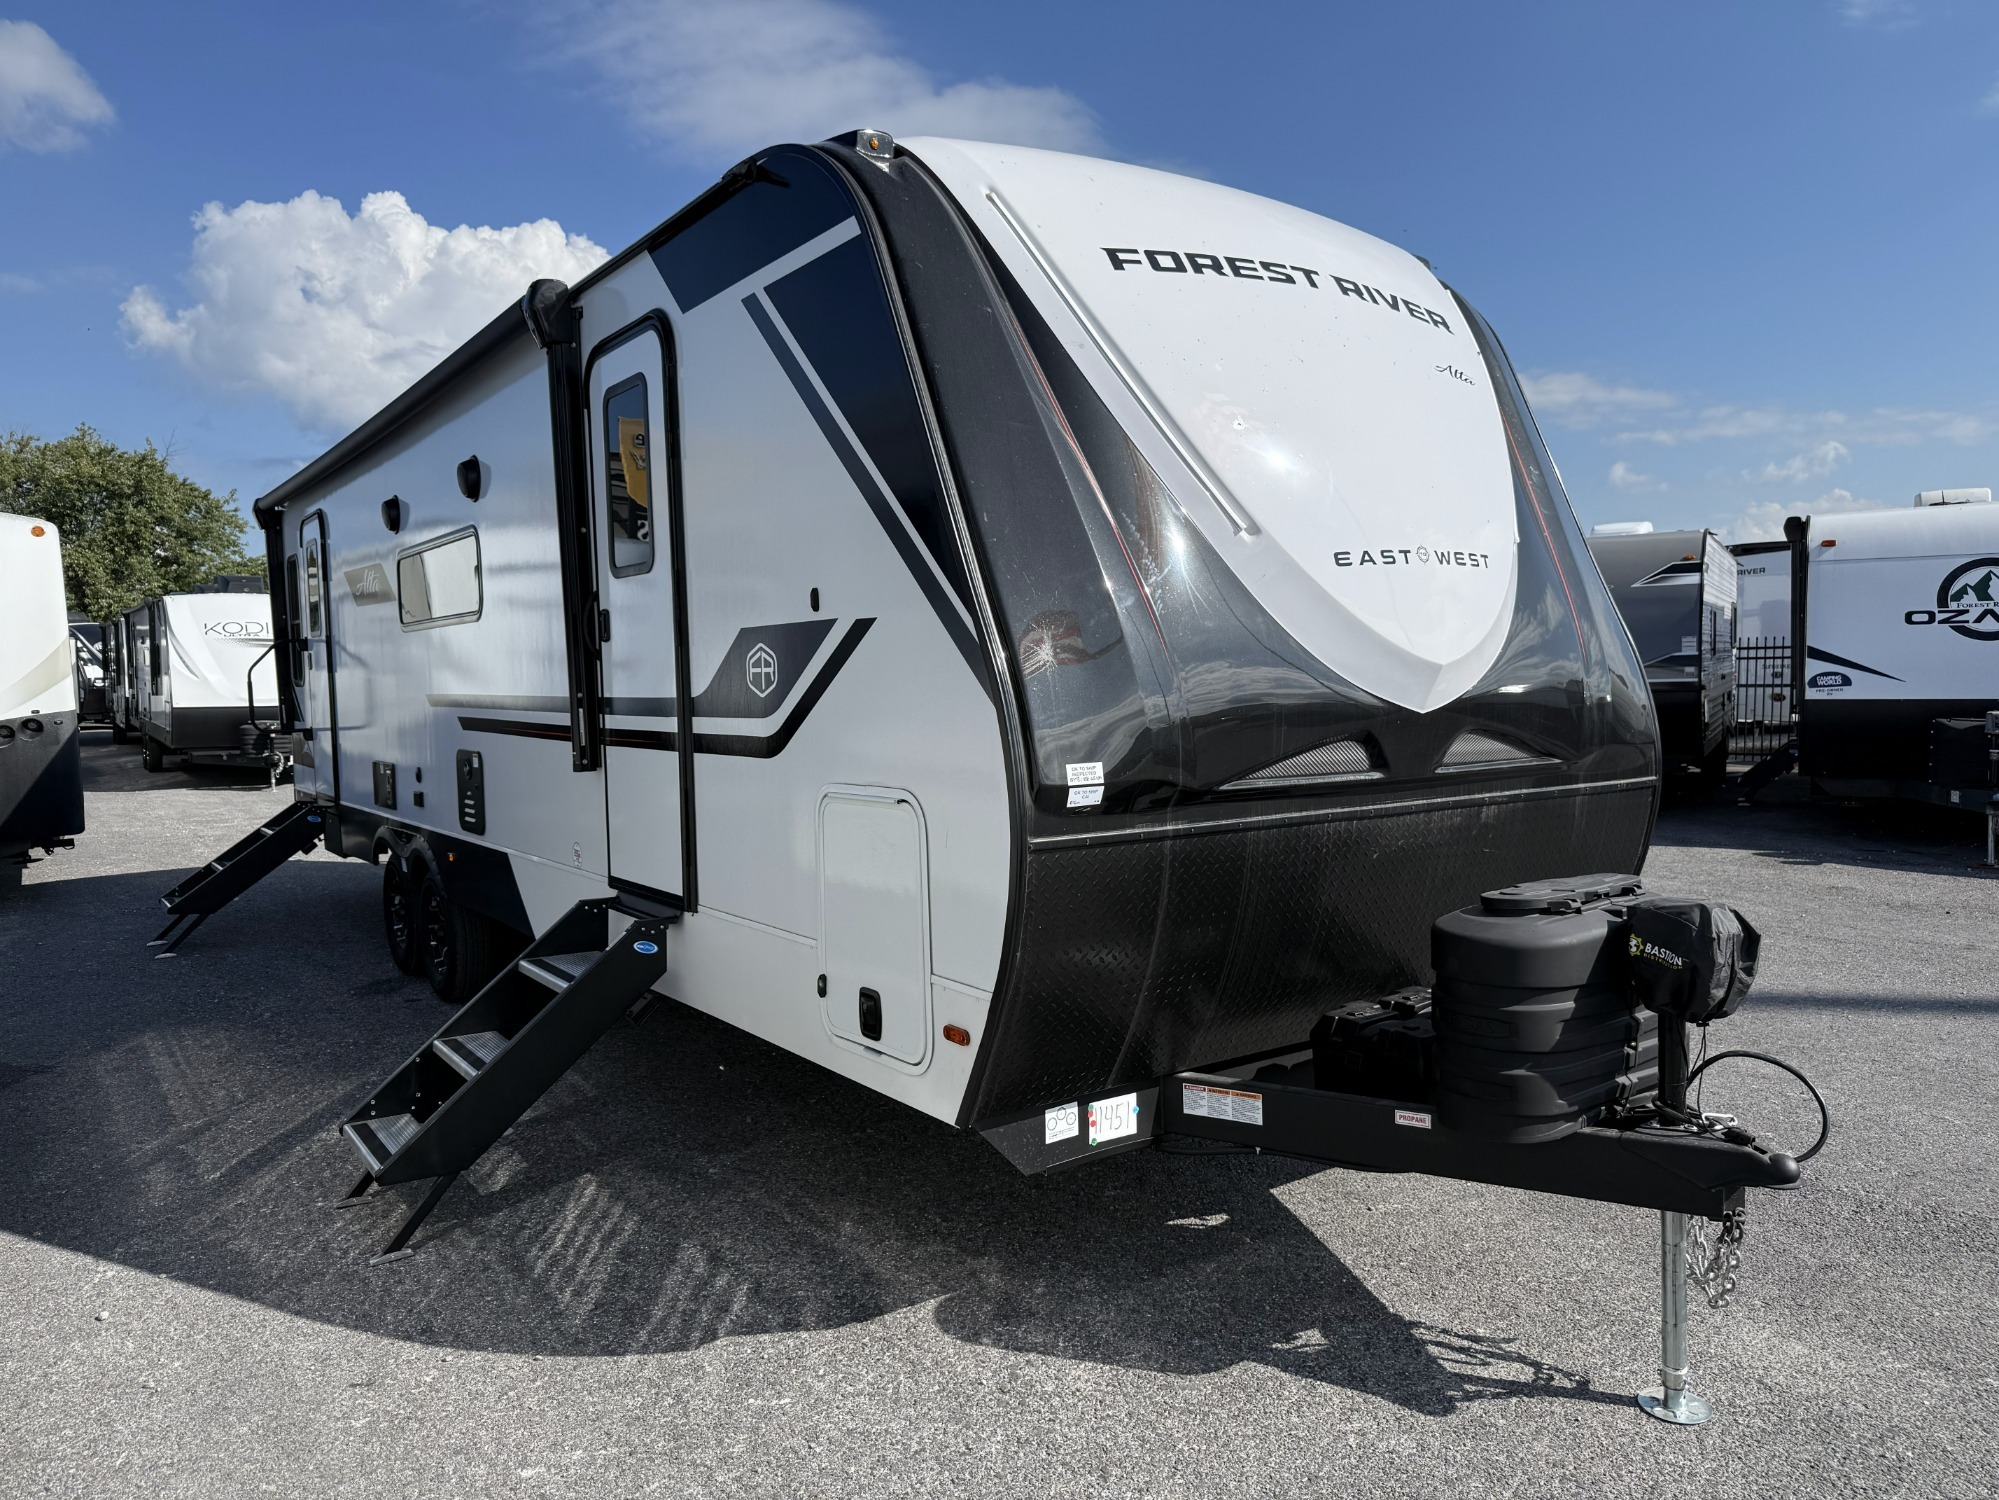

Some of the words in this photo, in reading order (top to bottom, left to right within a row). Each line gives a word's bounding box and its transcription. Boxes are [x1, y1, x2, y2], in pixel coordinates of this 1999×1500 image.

[1099, 247, 1321, 290] FOREST
[1329, 273, 1455, 336] RIVER
[1333, 549, 1412, 567] EAST
[1433, 550, 1489, 569] WEST
[204, 621, 269, 636] KODI
[1644, 942, 1683, 966] BASTION
[1398, 1114, 1427, 1125] PROPANE
